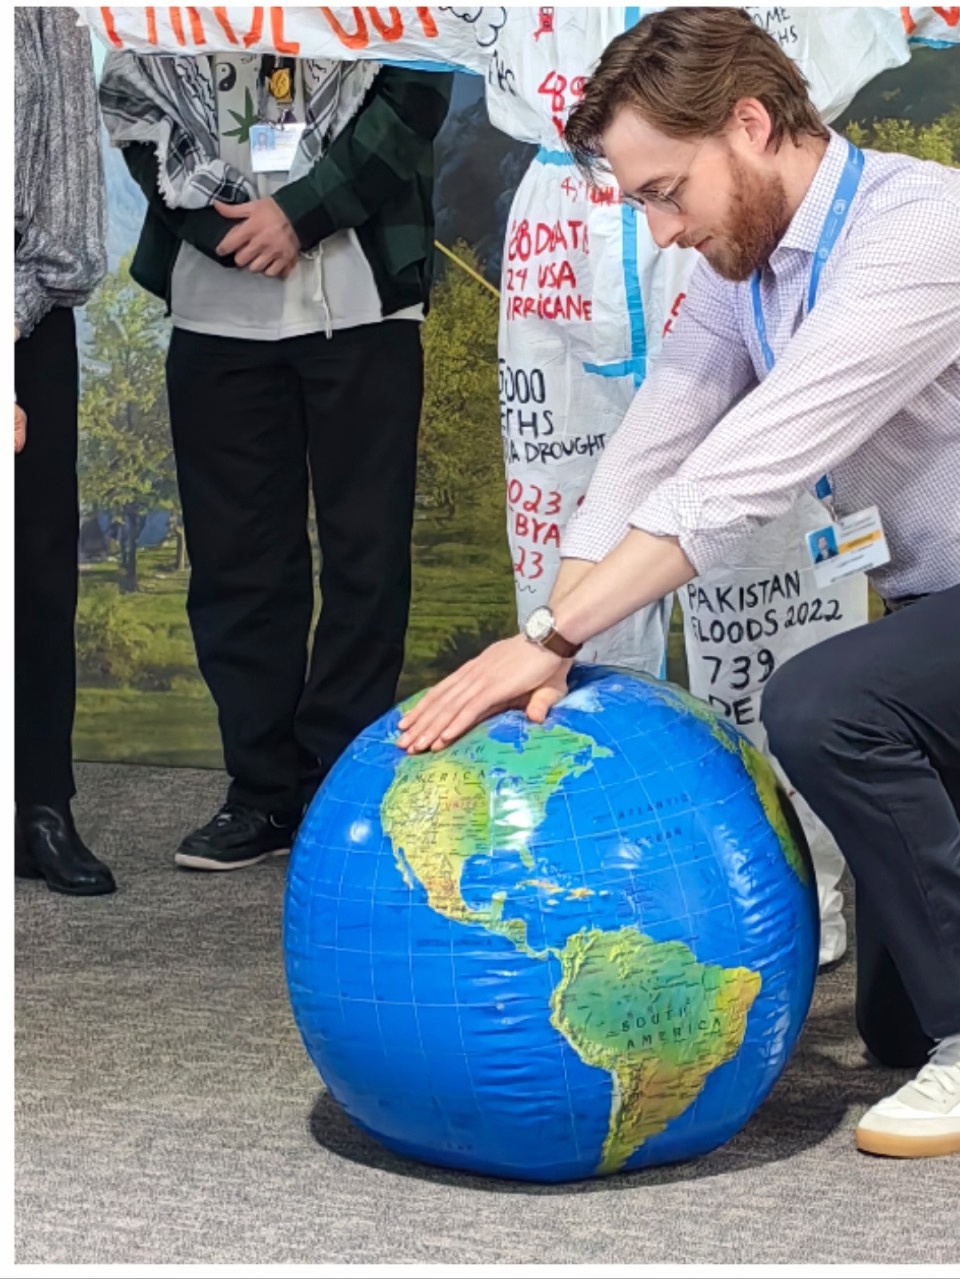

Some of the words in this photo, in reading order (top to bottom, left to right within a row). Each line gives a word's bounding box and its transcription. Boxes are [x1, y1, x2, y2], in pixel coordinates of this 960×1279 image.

[537, 260, 577, 289] USA
[524, 432, 606, 464] DROUGHT
[507, 478, 561, 515] 023
[687, 569, 800, 614] PAKISTAN
[784, 597, 843, 629] 2022
[626, 1016, 723, 1050] AMERICA
